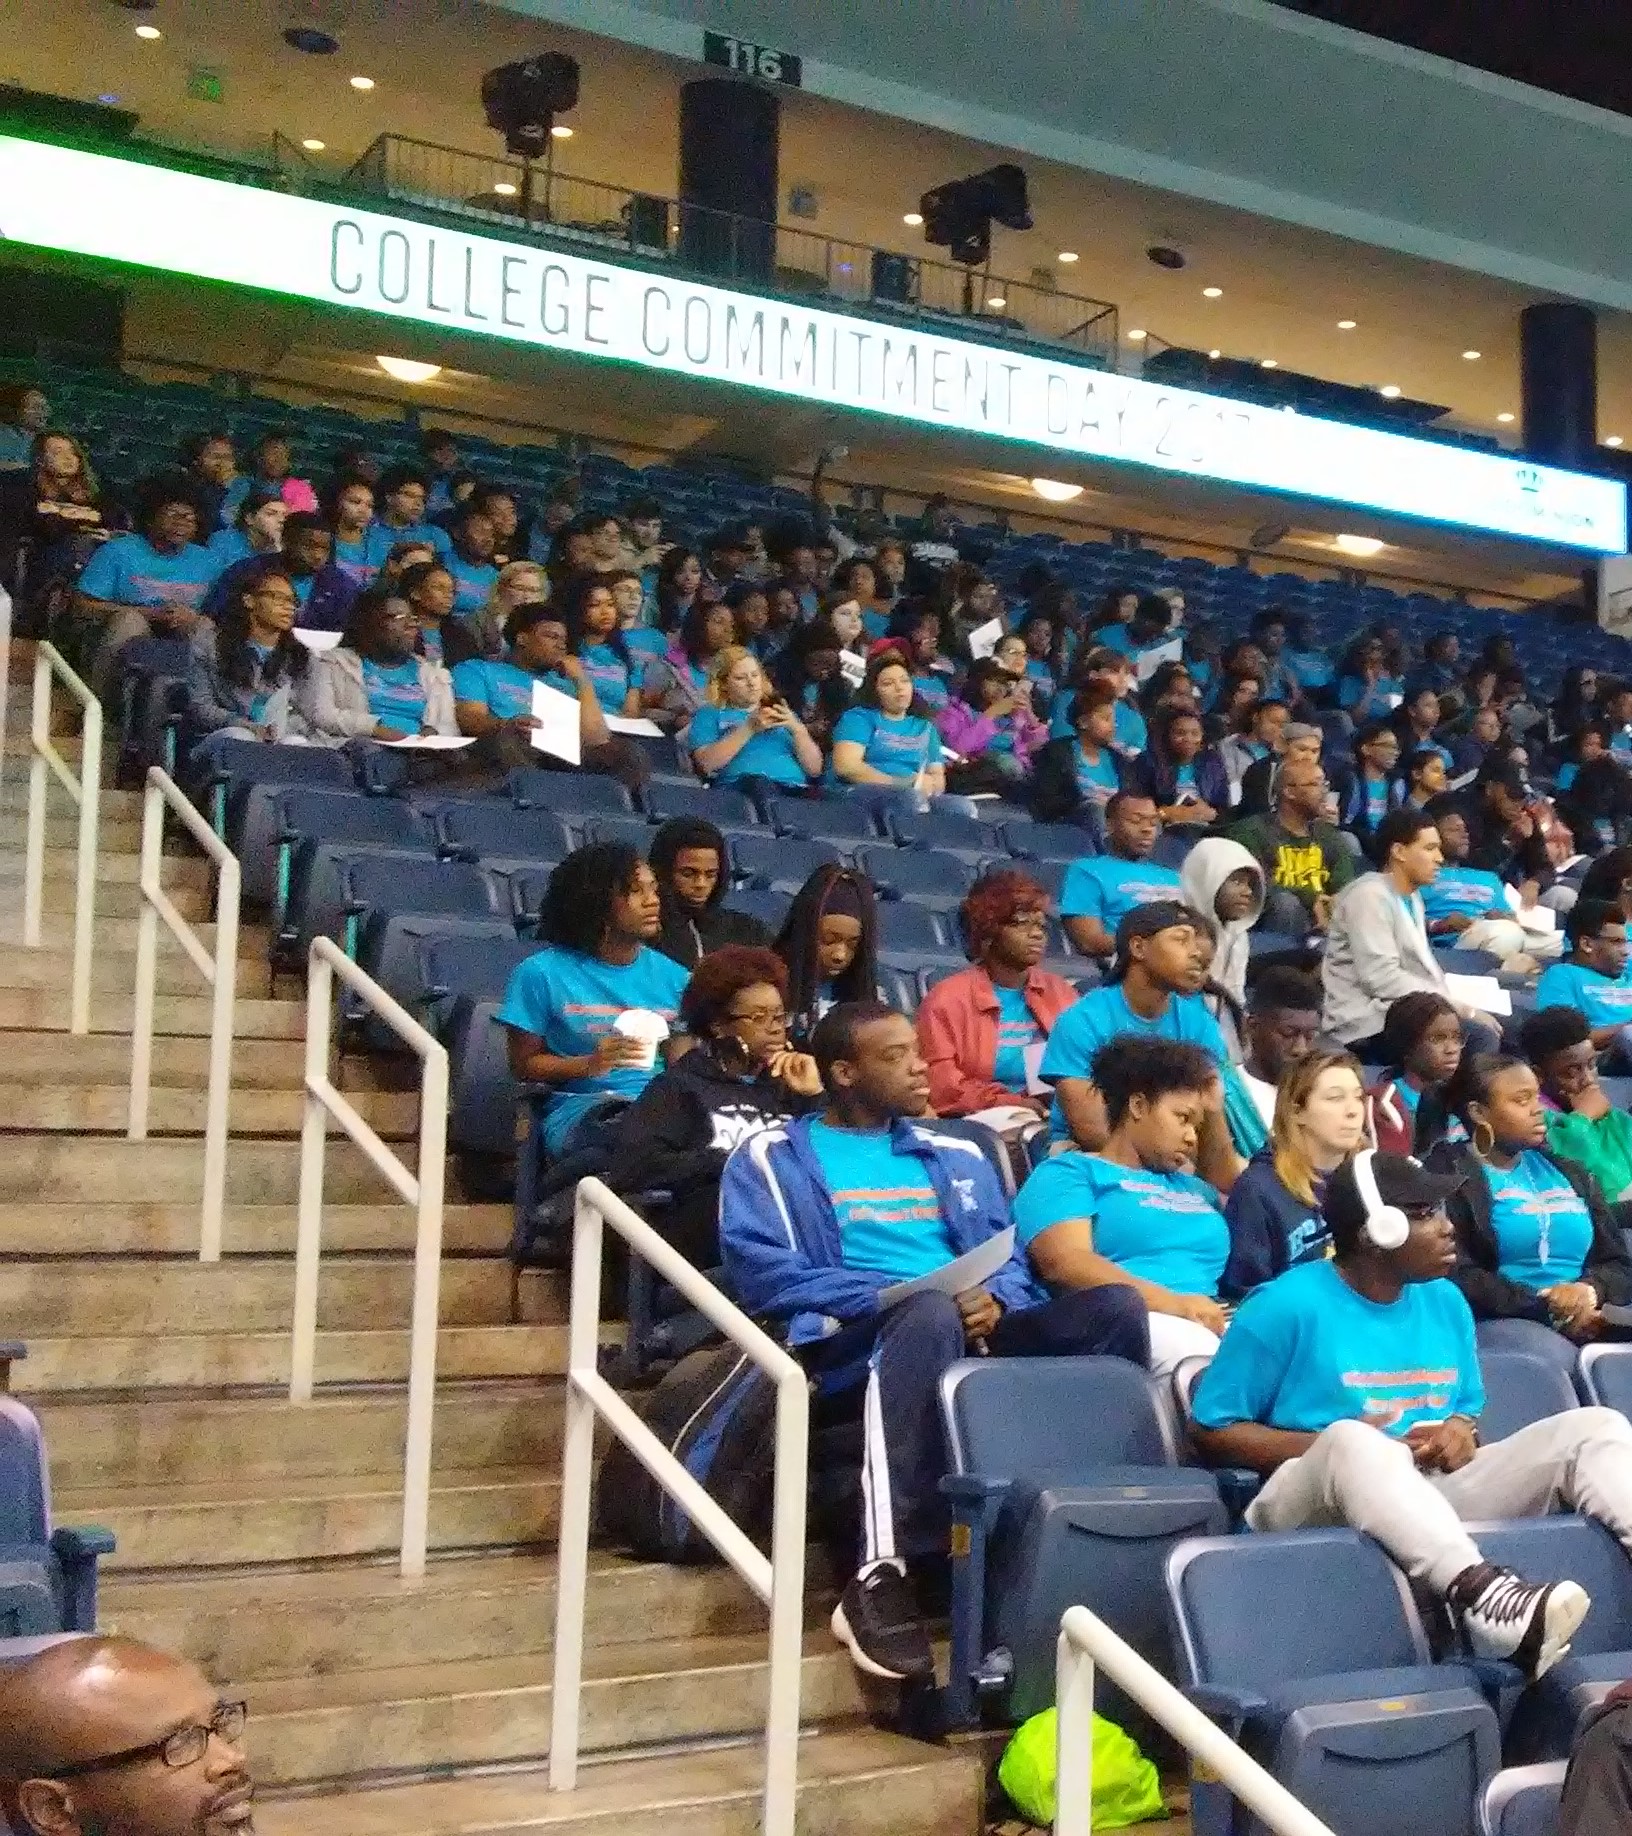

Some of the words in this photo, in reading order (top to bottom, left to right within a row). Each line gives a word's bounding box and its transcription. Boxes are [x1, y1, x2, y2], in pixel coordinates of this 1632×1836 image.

[724, 40, 782, 79] 116
[330, 219, 610, 345] COLLEGE
[642, 286, 1022, 425] COMMITMENT
[1047, 374, 1132, 447] DAY
